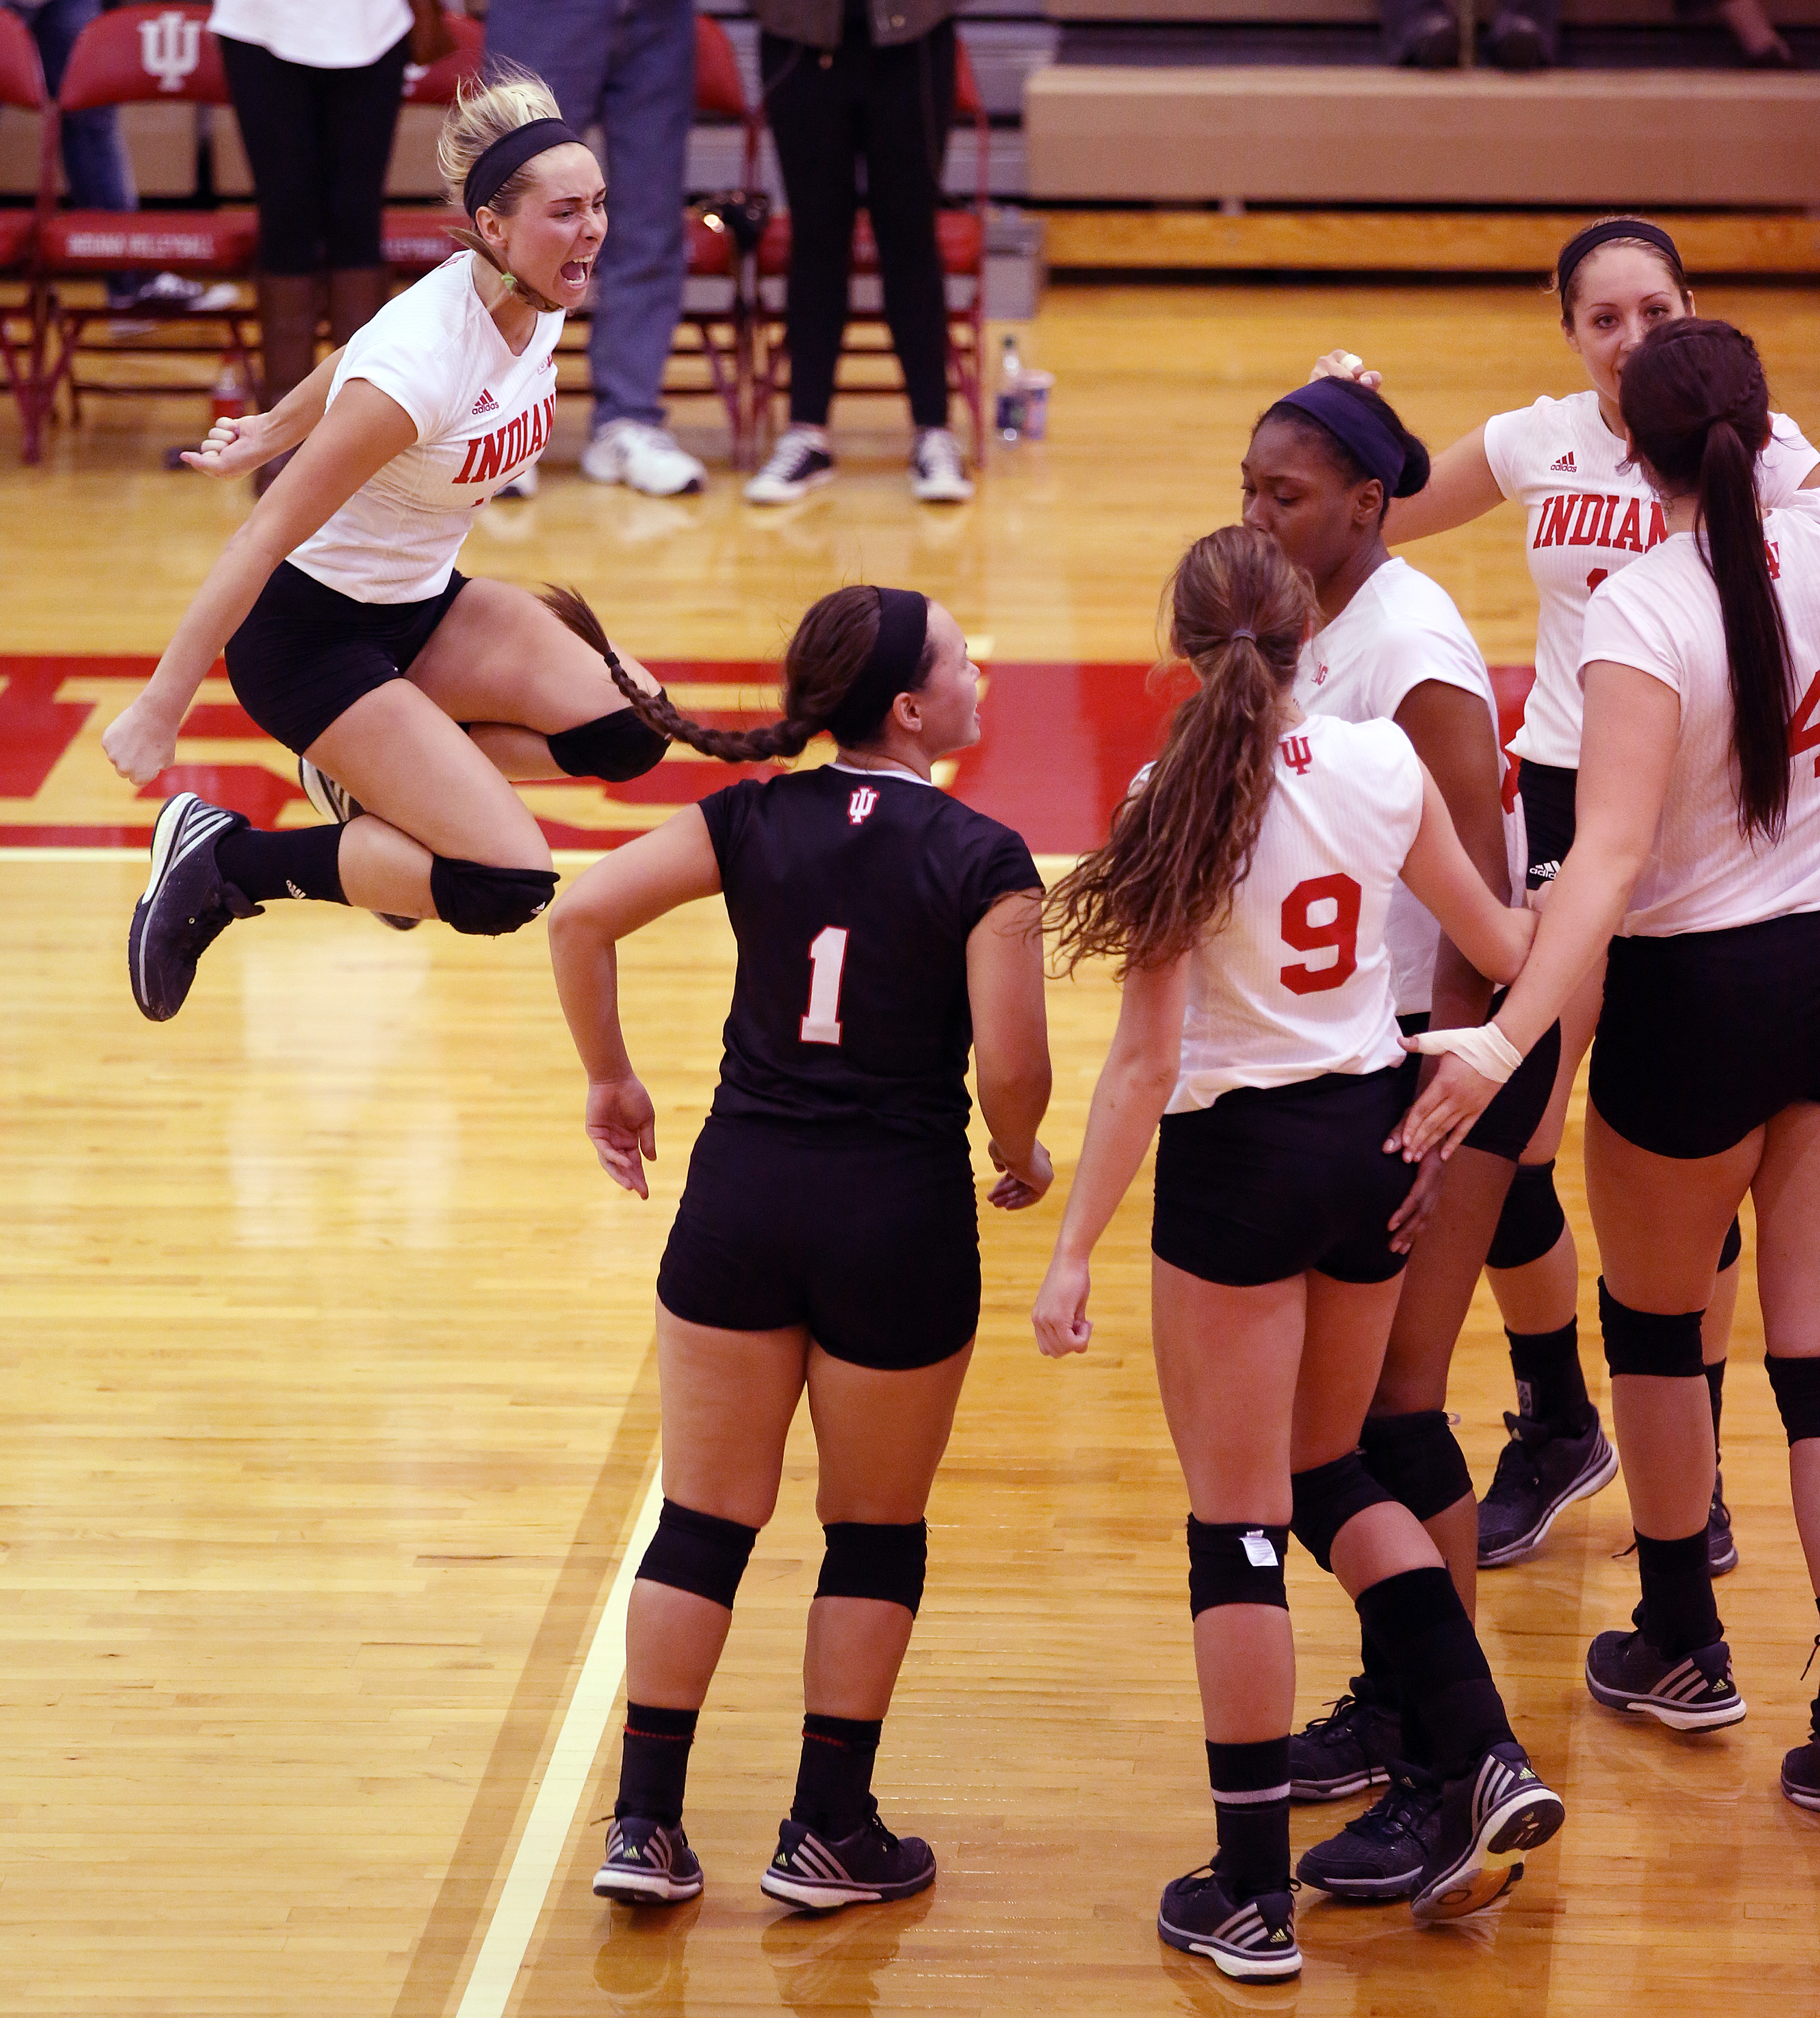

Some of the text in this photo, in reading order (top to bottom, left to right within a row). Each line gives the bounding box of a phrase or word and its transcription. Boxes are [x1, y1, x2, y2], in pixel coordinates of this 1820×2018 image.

[471, 400, 500, 415] adidas
[1550, 463, 1578, 473] adidas
[1280, 872, 1362, 996] 9
[798, 923, 850, 1047] 1
